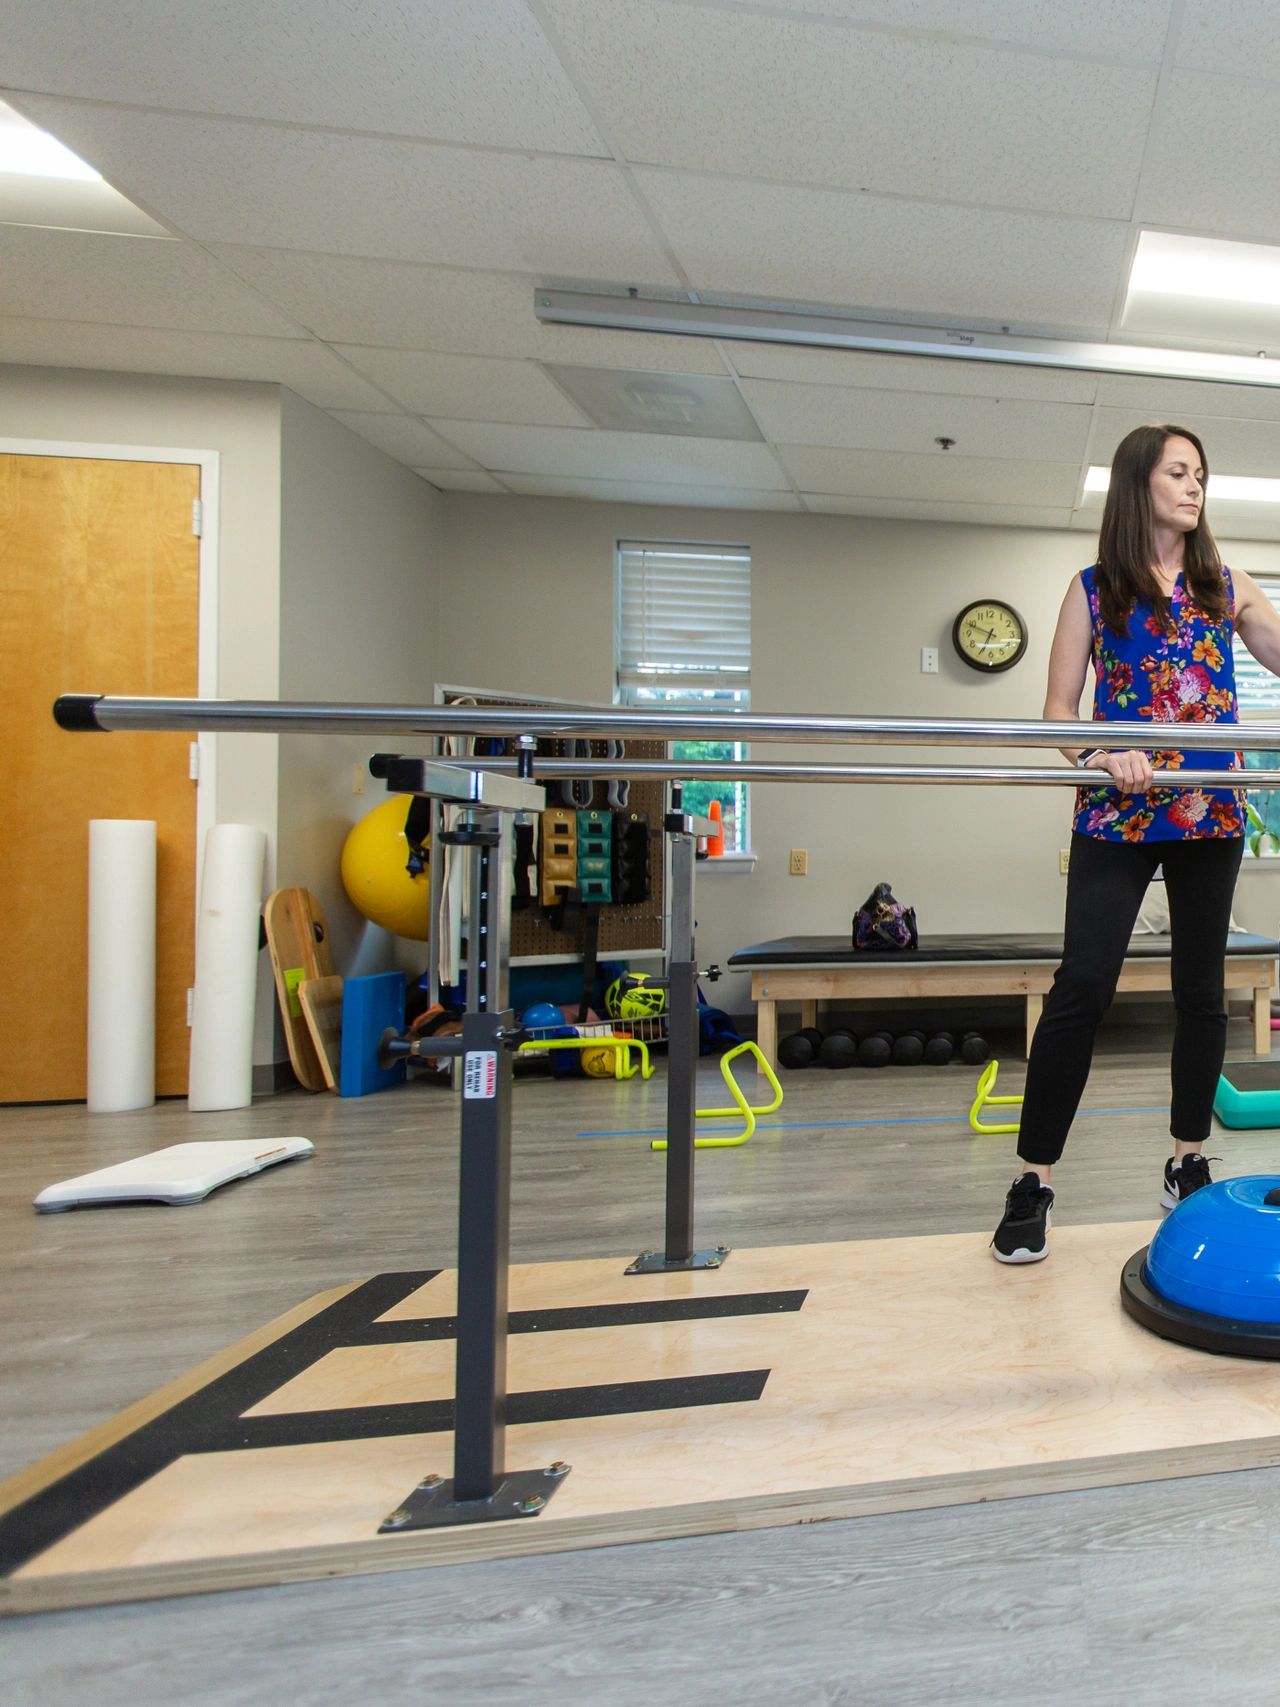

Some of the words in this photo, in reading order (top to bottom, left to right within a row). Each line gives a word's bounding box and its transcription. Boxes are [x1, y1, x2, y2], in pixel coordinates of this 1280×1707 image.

[986, 610, 995, 618] 12
[1005, 619, 1012, 628] 2
[1009, 630, 1015, 638] 3
[969, 639, 976, 648] 8
[999, 647, 1005, 656] 5
[481, 891, 488, 899] 2
[480, 926, 487, 934] 3
[480, 995, 487, 1003] 5
[486, 1060, 496, 1095] WARNING
